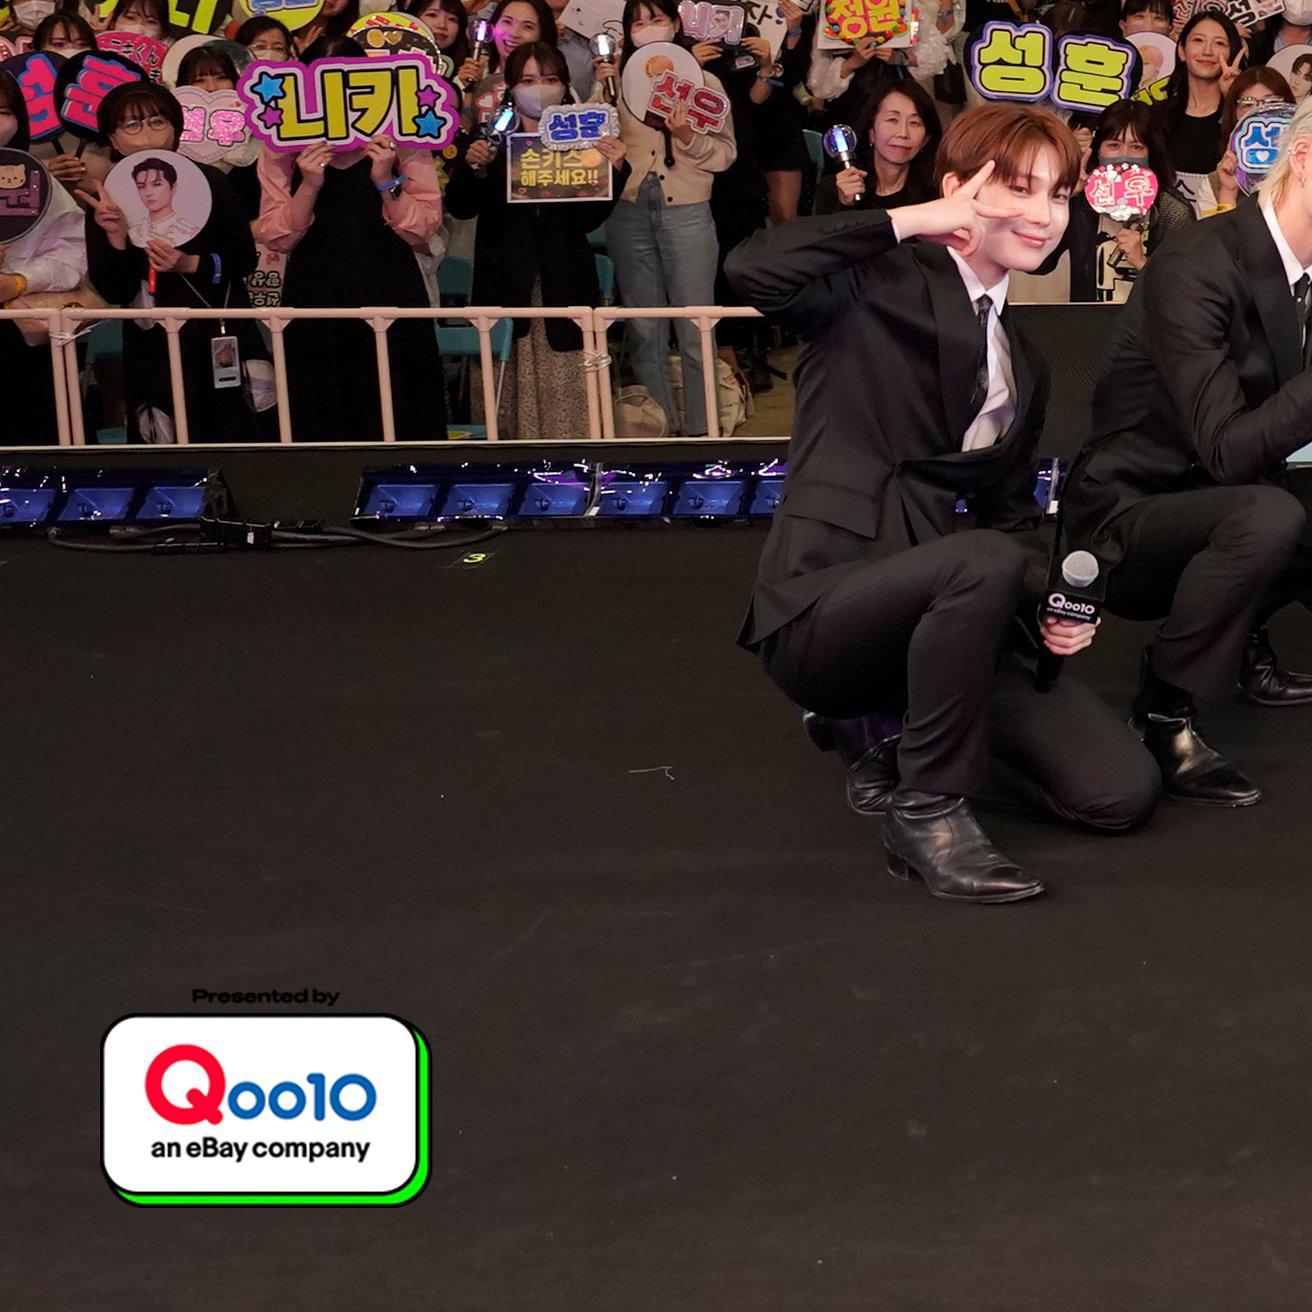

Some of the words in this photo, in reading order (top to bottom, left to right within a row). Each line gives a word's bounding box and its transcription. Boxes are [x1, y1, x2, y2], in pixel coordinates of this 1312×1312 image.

[680, 2, 743, 42] 니키
[977, 29, 1131, 108] 성훈
[280, 64, 420, 143] 니키
[651, 74, 727, 134] 선우
[547, 114, 606, 142] 성훈
[519, 152, 583, 170] 손키스
[520, 171, 599, 188] 해주세요!!
[1089, 179, 1154, 208] 선우
[1048, 592, 1095, 615] Qoo10
